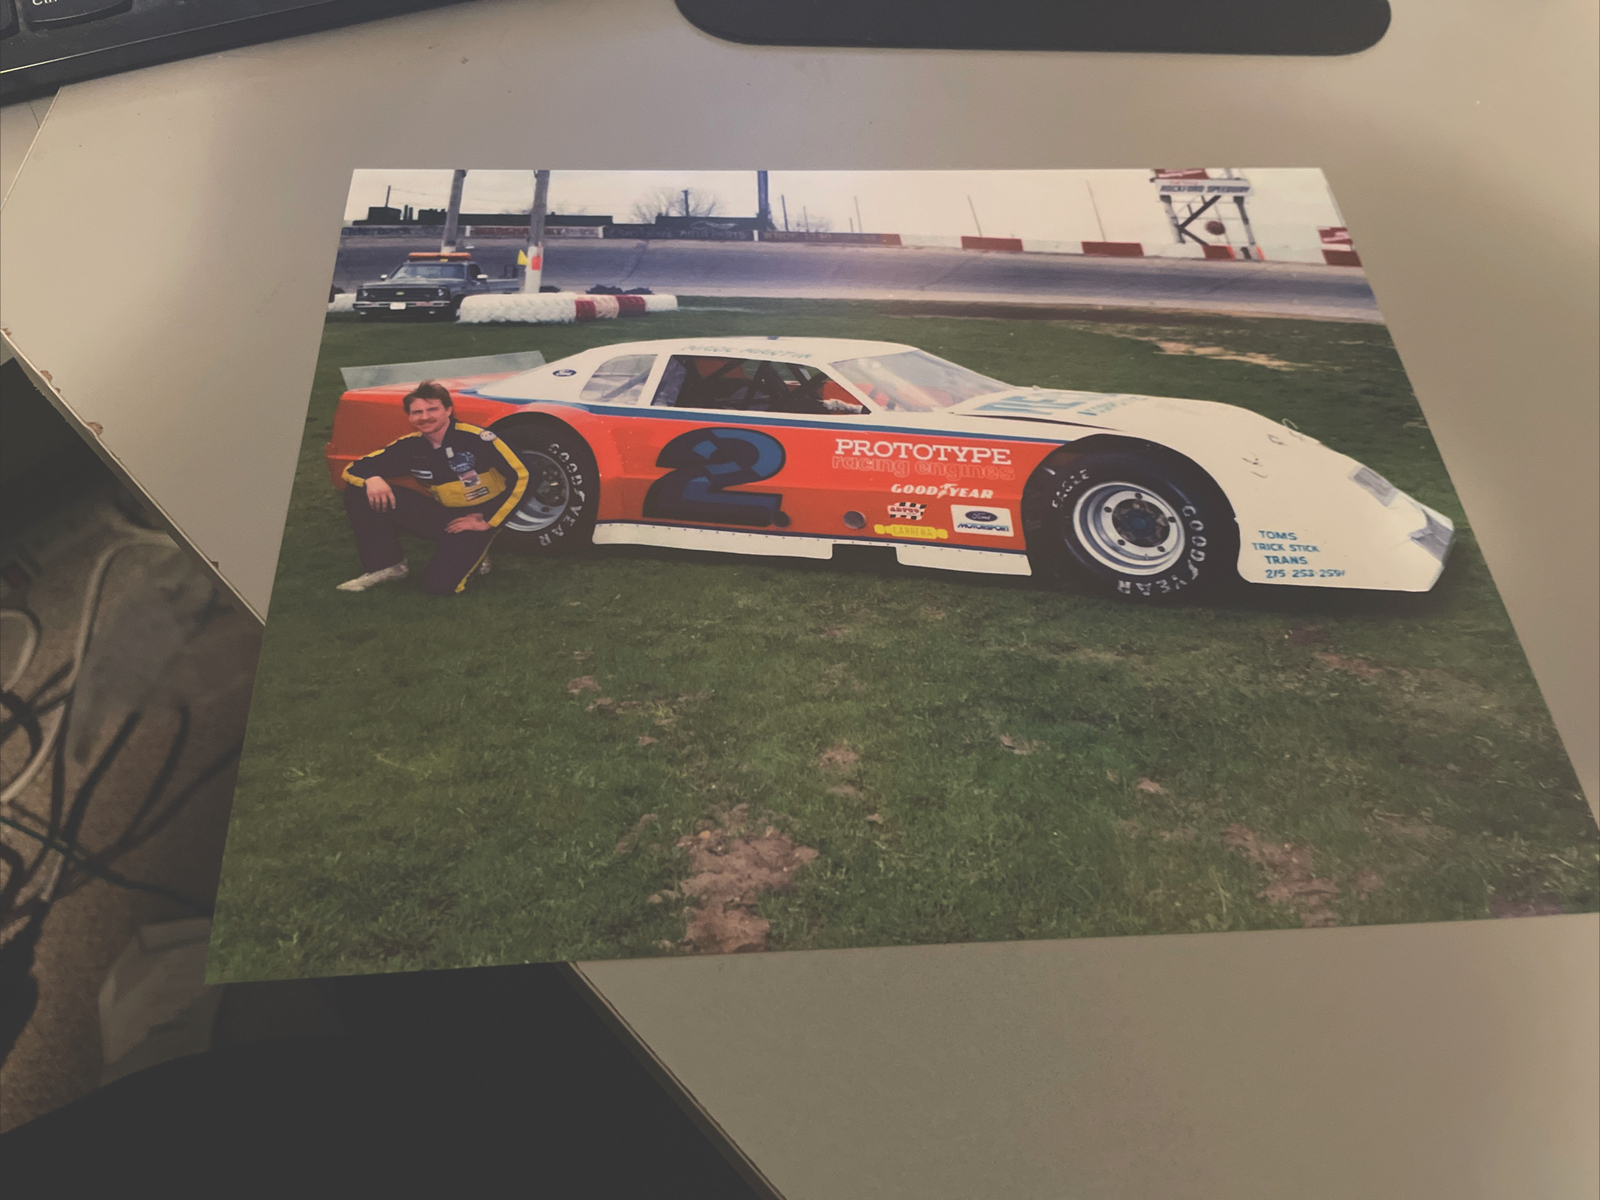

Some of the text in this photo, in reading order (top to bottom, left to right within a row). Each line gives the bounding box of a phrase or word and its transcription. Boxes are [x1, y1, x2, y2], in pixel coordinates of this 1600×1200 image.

[834, 438, 1012, 465] PROTOTYPE
[832, 455, 1016, 481] racing engines
[642, 427, 786, 527] 2
[891, 483, 994, 499] GOODYEAR
[971, 512, 991, 520] Ford
[893, 524, 933, 538] CARRERA
[957, 522, 1009, 532] MOTORSPORT
[1258, 530, 1297, 541] TOMS
[1251, 542, 1320, 552] TRICK STICK
[1264, 555, 1308, 565] TRANS
